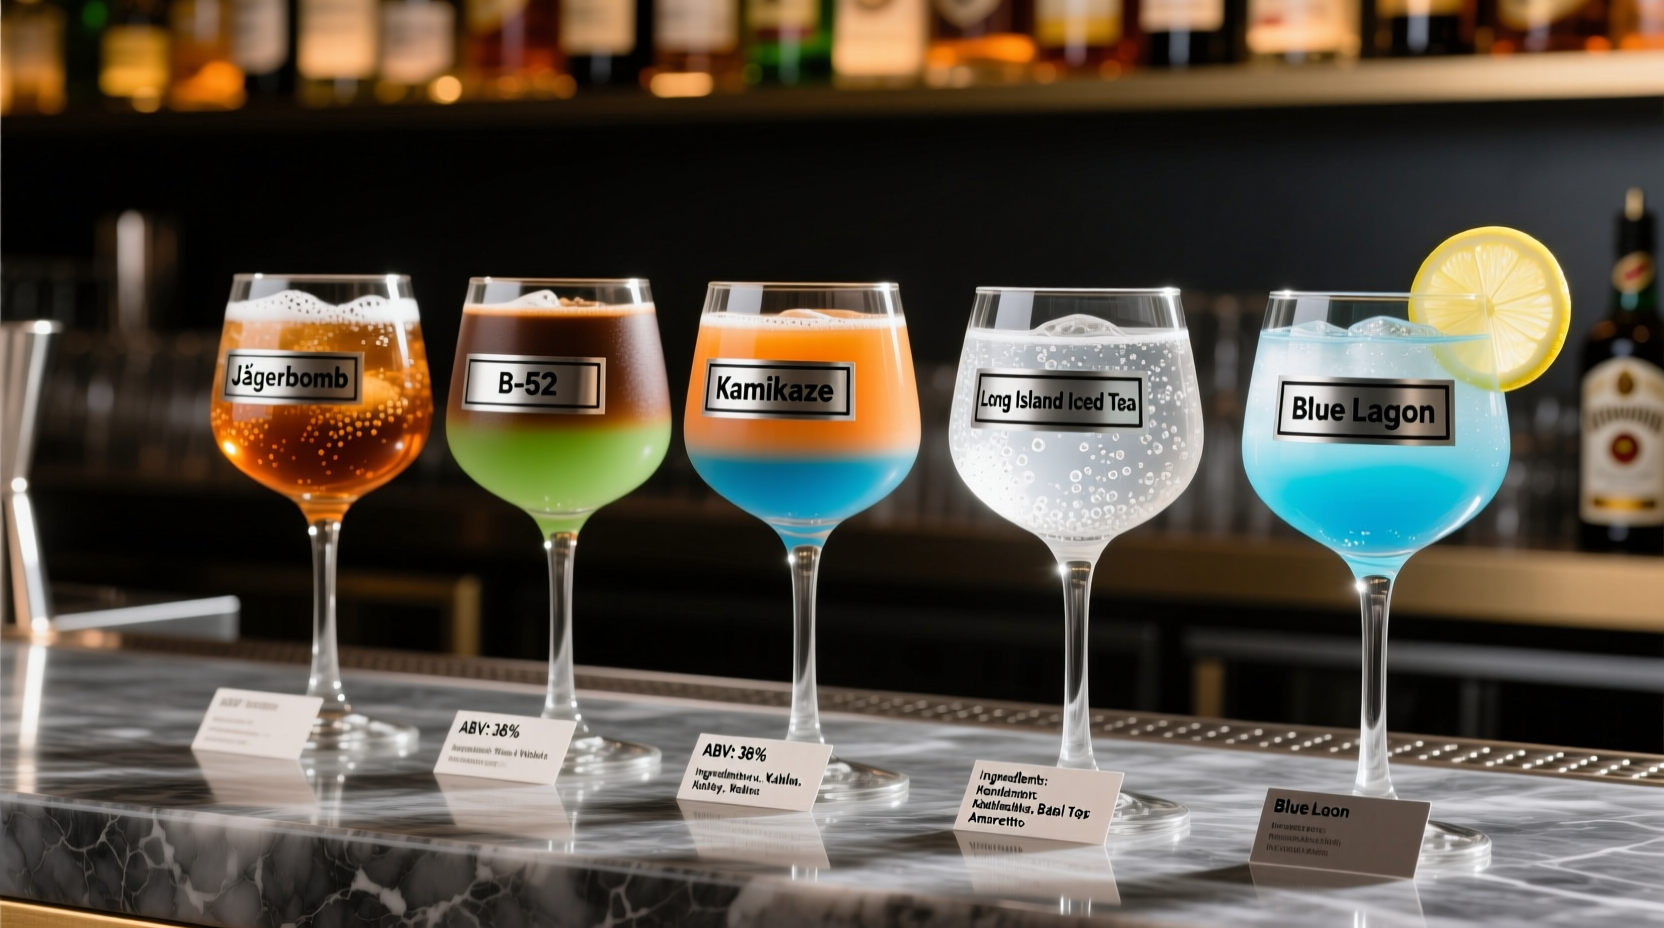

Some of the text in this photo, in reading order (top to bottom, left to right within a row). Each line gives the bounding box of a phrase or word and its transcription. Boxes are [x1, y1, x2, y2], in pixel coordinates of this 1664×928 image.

[498, 371, 558, 396] B-52
[716, 375, 834, 403] Kamikaze
[980, 389, 1137, 413] Long Island Iced Tea
[1292, 396, 1435, 431] Blue Lagon
[458, 720, 490, 736] ABV:
[702, 742, 767, 762] ABV: 38%
[1274, 798, 1309, 815] Blue
